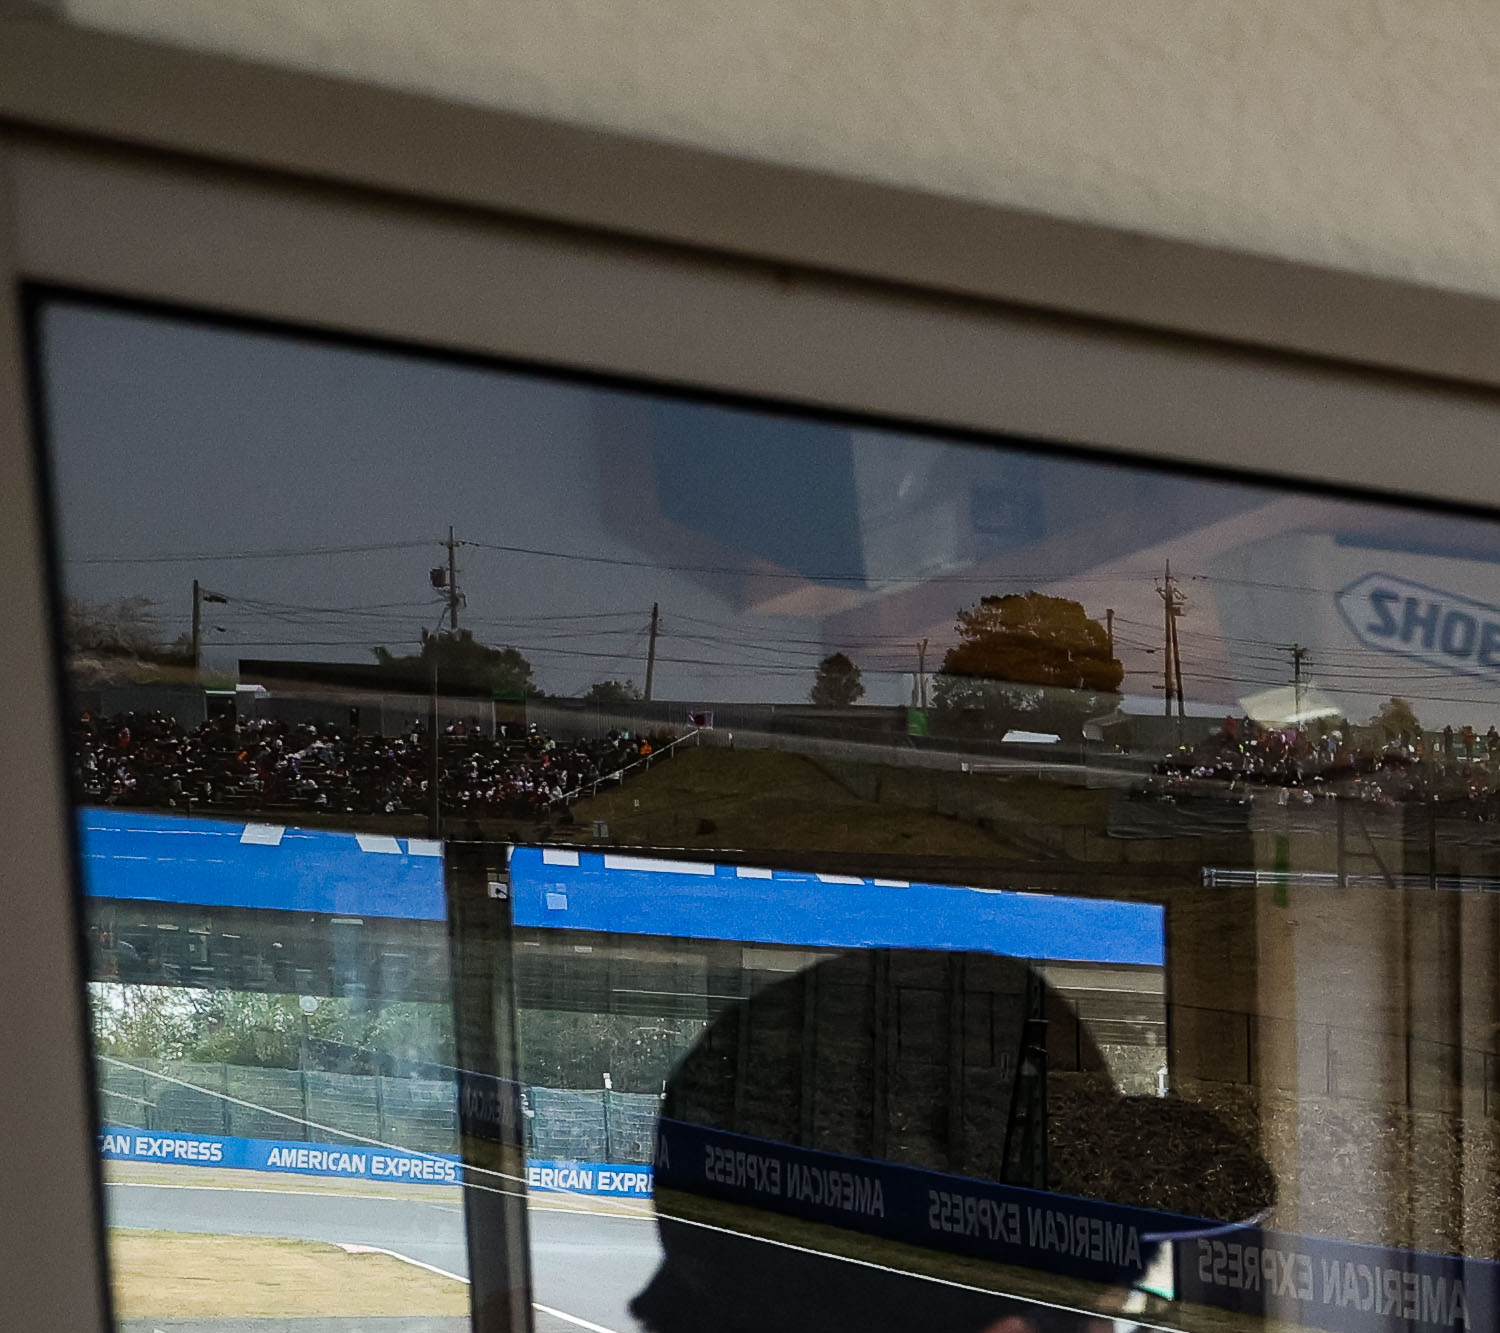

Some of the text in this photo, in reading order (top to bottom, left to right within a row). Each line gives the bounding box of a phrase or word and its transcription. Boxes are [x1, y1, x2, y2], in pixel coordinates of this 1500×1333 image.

[99, 1134, 224, 1162] AN EXPRESS
[267, 1147, 456, 1182] AMERICAN EXPRESS
[525, 1166, 593, 1190] ERICAN
